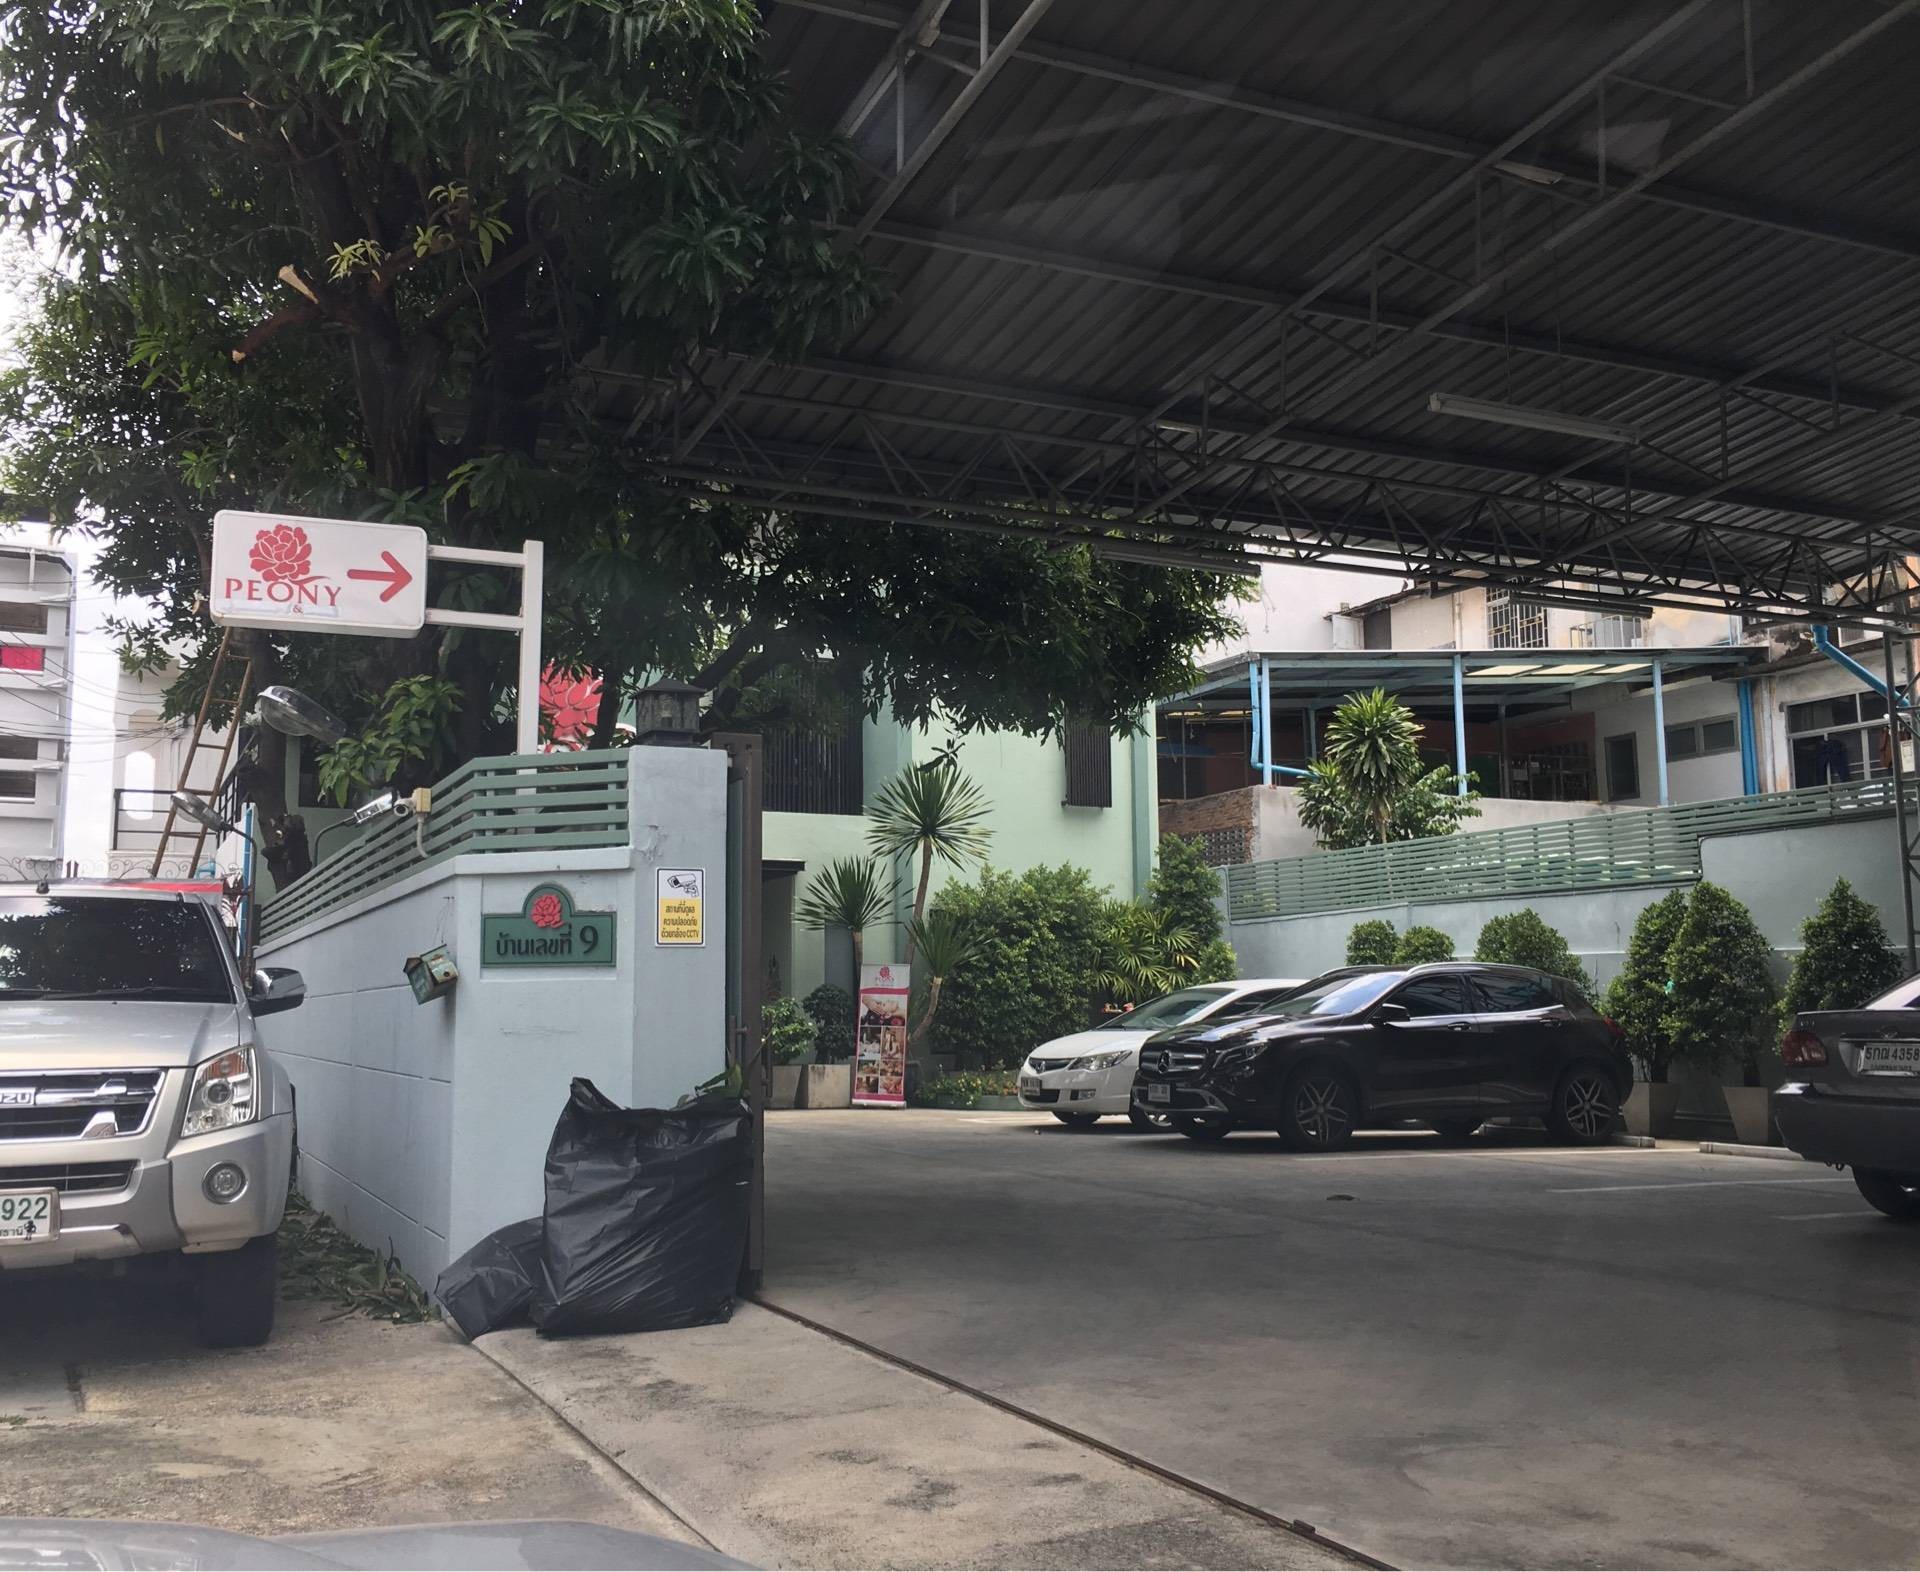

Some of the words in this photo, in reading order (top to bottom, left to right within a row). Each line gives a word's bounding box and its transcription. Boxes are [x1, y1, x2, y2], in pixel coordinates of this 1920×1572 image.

[225, 577, 341, 606] PEONY
[496, 922, 572, 956] บ้านเลขที่
[580, 925, 599, 954] 9
[0, 1092, 32, 1105] ZU
[1, 1197, 49, 1221] 922
